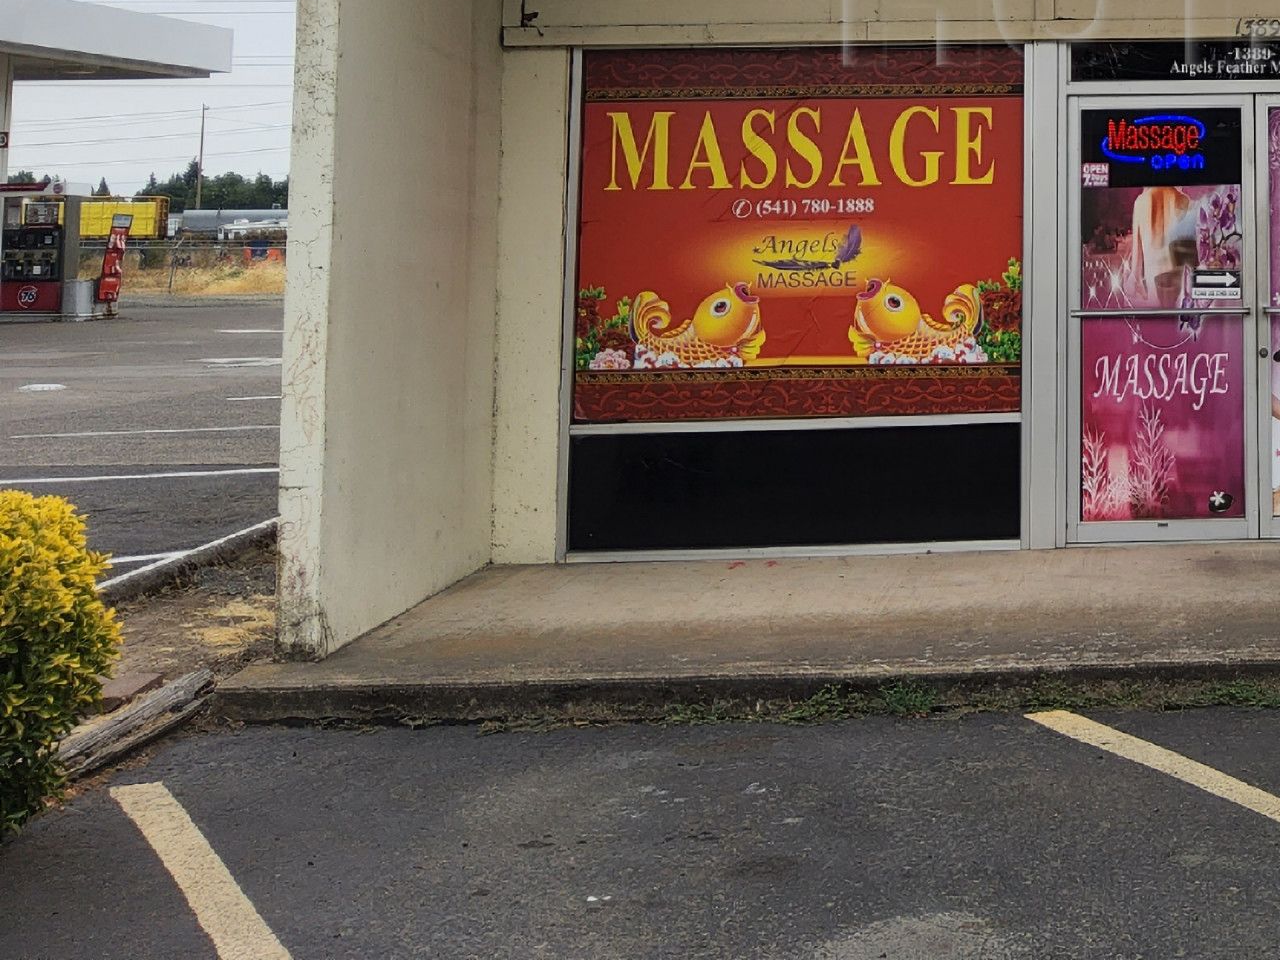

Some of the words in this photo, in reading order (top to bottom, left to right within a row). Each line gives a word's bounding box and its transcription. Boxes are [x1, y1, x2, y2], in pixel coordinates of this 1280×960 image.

[1235, 18, 1280, 37] 1389
[1170, 60, 1214, 76] Angels
[1217, 60, 1266, 74] Feather
[1107, 119, 1199, 155] Massage
[604, 105, 996, 191] MASSAGE
[1083, 163, 1109, 174] OPEN
[756, 199, 797, 217] (541)
[802, 198, 874, 214] 780-1888
[760, 232, 839, 257] Angels
[757, 271, 857, 289] MASSAGE
[21, 290, 37, 302] 76
[1093, 352, 1229, 411] MASSAGE
